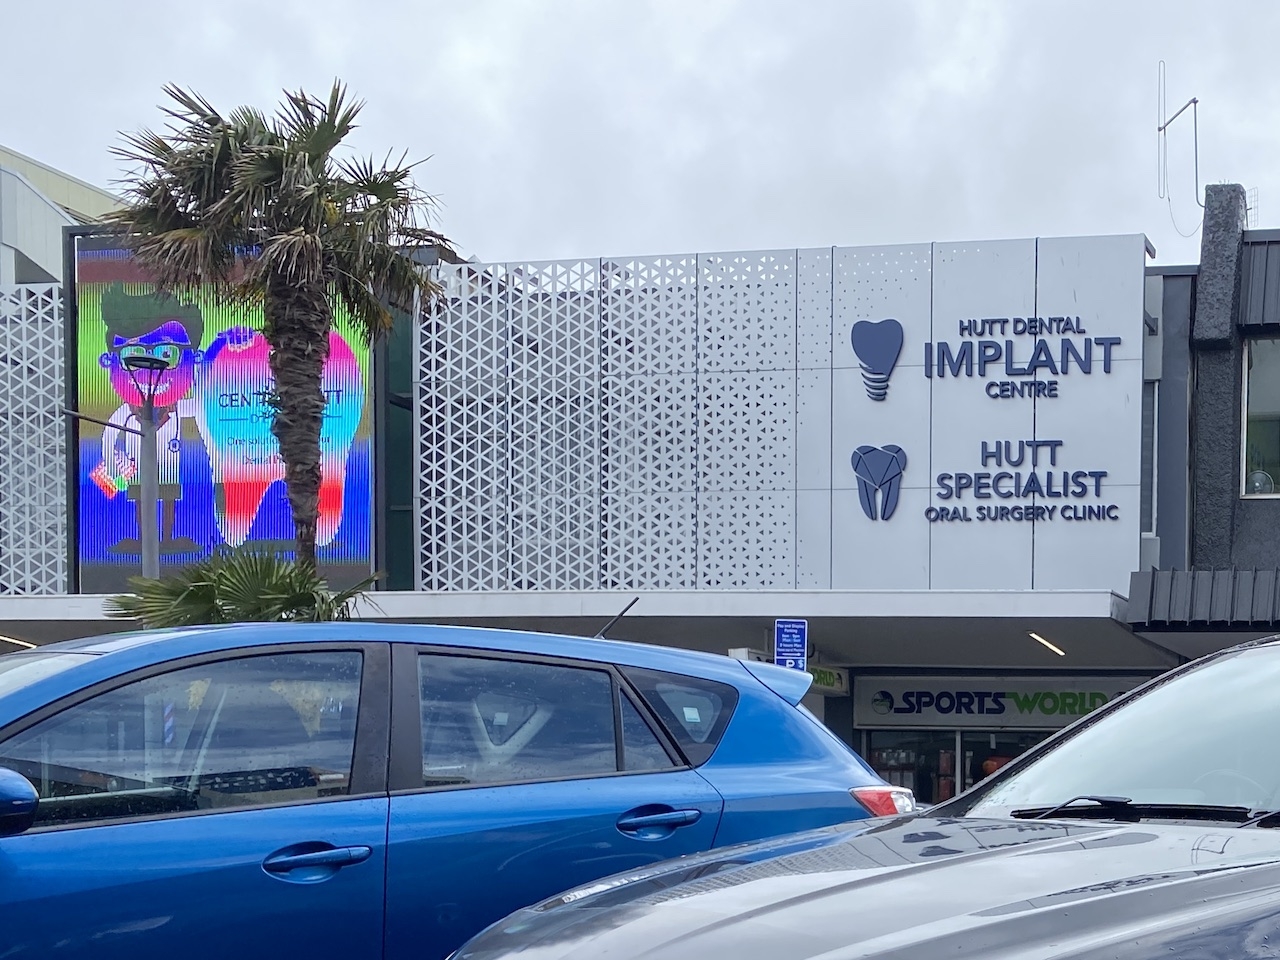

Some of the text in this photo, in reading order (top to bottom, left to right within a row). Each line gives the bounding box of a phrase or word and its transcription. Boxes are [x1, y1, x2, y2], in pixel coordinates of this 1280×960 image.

[959, 316, 1086, 336] HUTT DENTAL
[924, 337, 1122, 378] IMPLANT
[985, 380, 1058, 398] CENTRE
[248, 437, 279, 446] solutio
[981, 440, 1063, 467] HUTT
[936, 471, 1107, 499] SPECIALIST
[925, 504, 1119, 522] ORAL SURGERY CLINIC
[786, 660, 795, 668] P
[810, 668, 834, 687] ORLD
[894, 691, 1006, 715] SPORTS
[1006, 691, 1109, 715] WORLD
